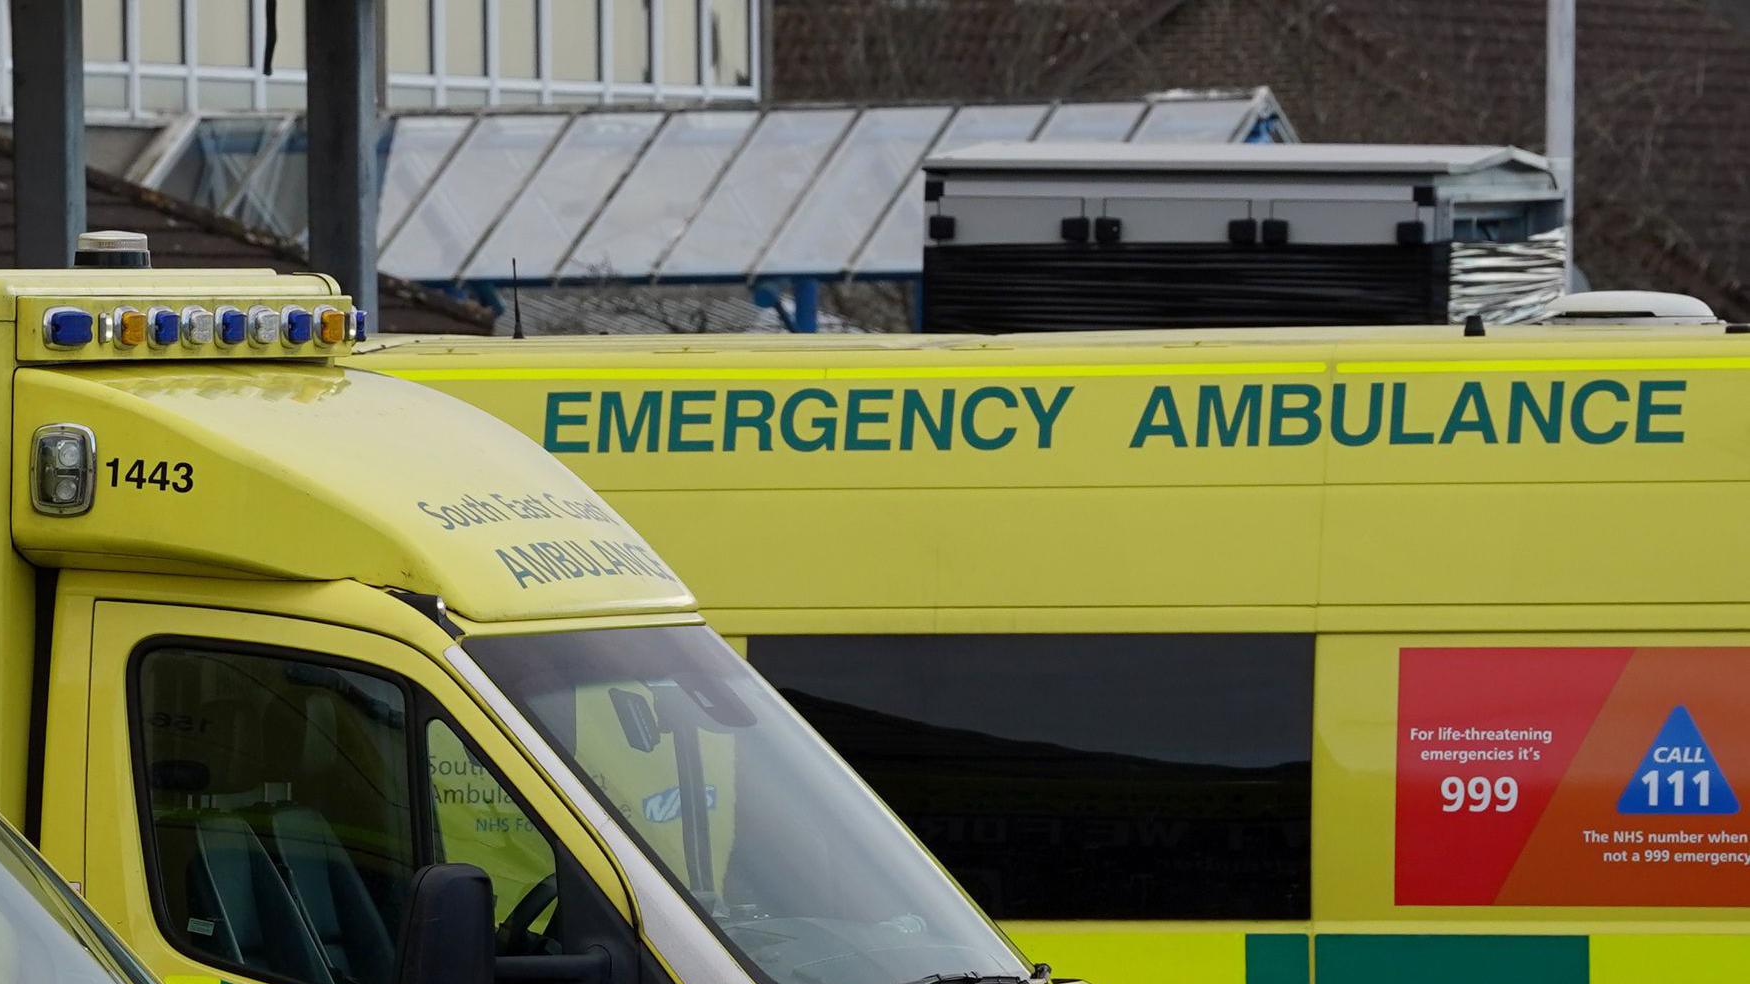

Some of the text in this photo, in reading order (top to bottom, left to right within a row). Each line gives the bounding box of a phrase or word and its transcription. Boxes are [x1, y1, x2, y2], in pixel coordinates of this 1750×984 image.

[542, 379, 1687, 453] EMERGENCY AMBULANCE
[105, 458, 195, 494] 1443
[416, 493, 511, 530] South
[490, 493, 563, 520] East
[495, 540, 677, 589] AMBULANCE
[1410, 726, 1553, 743] For life-threatening
[430, 755, 483, 776] Sout
[1420, 749, 1514, 764] emergencies
[1653, 746, 1706, 764] CALL
[1440, 776, 1519, 812] 999
[1641, 770, 1710, 806] 111
[1583, 829, 1749, 844] The NHS number when
[1603, 850, 1750, 867] not a 999 emergency
